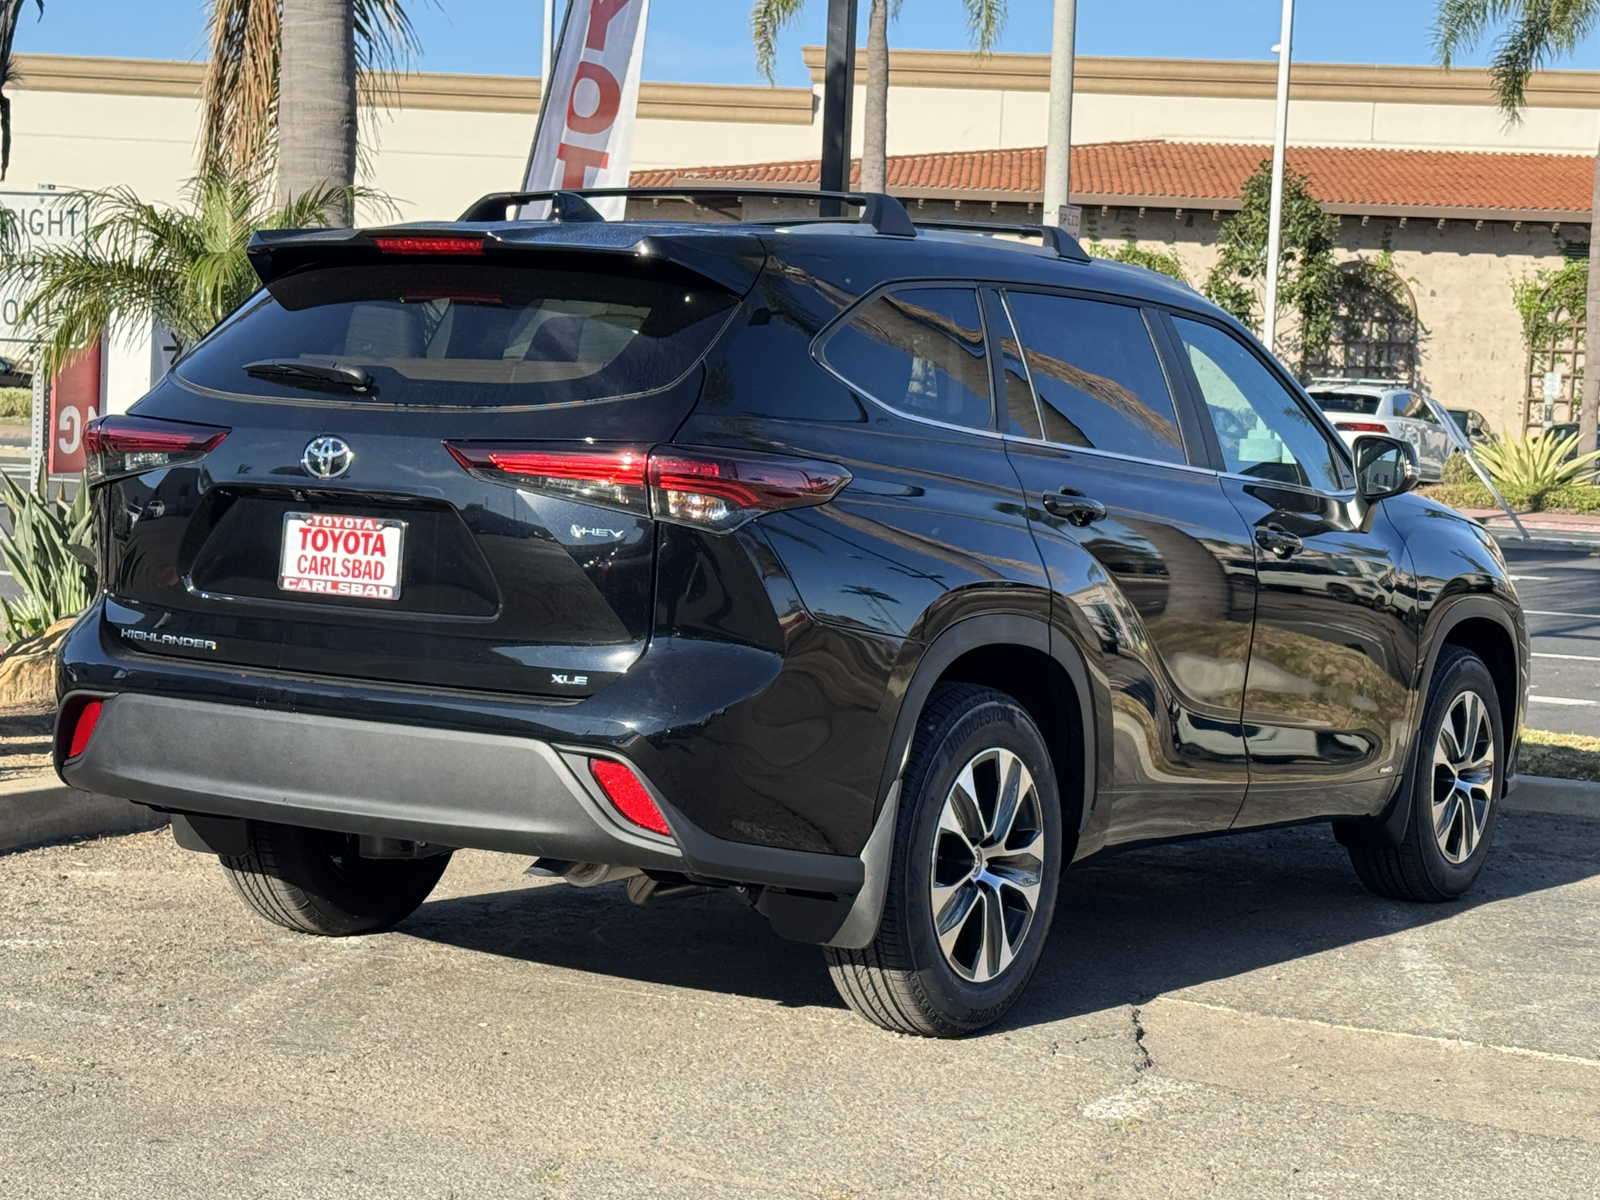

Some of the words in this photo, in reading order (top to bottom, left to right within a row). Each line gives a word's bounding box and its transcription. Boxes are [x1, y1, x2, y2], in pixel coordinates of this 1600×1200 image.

[313, 515, 374, 530] TOYOTA
[581, 526, 624, 538] HEV
[299, 527, 386, 557] TOYOTA
[297, 554, 385, 581] CARLSBAD
[283, 577, 393, 598] CARLSBAD
[120, 628, 217, 650] HIGHLANDER
[551, 673, 588, 686] XLE
